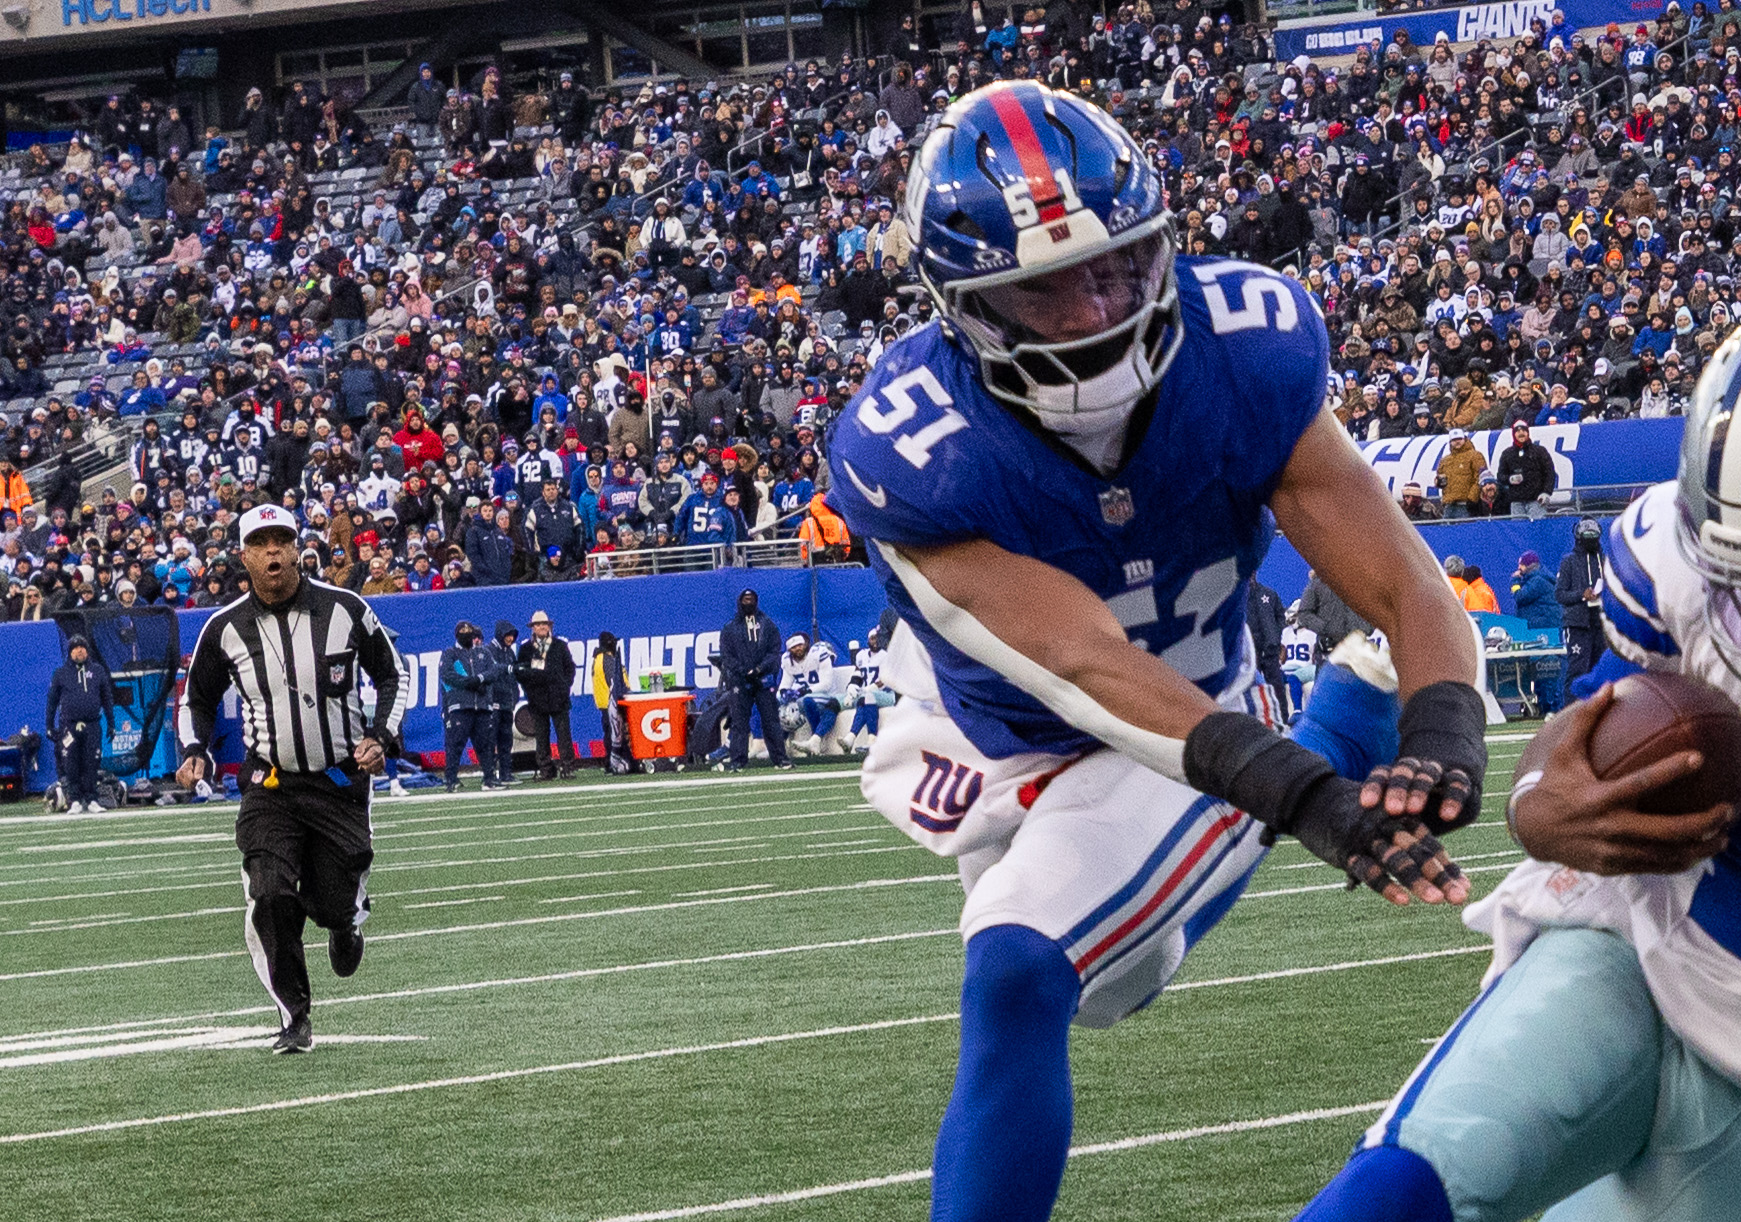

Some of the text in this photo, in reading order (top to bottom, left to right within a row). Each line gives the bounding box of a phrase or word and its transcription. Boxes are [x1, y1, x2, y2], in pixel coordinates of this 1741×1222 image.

[1002, 167, 1084, 230] 51
[858, 365, 970, 470] 51
[1361, 423, 1580, 504] GIANS
[692, 506, 716, 533] 5
[567, 630, 722, 697] GINTS
[640, 708, 671, 742] G
